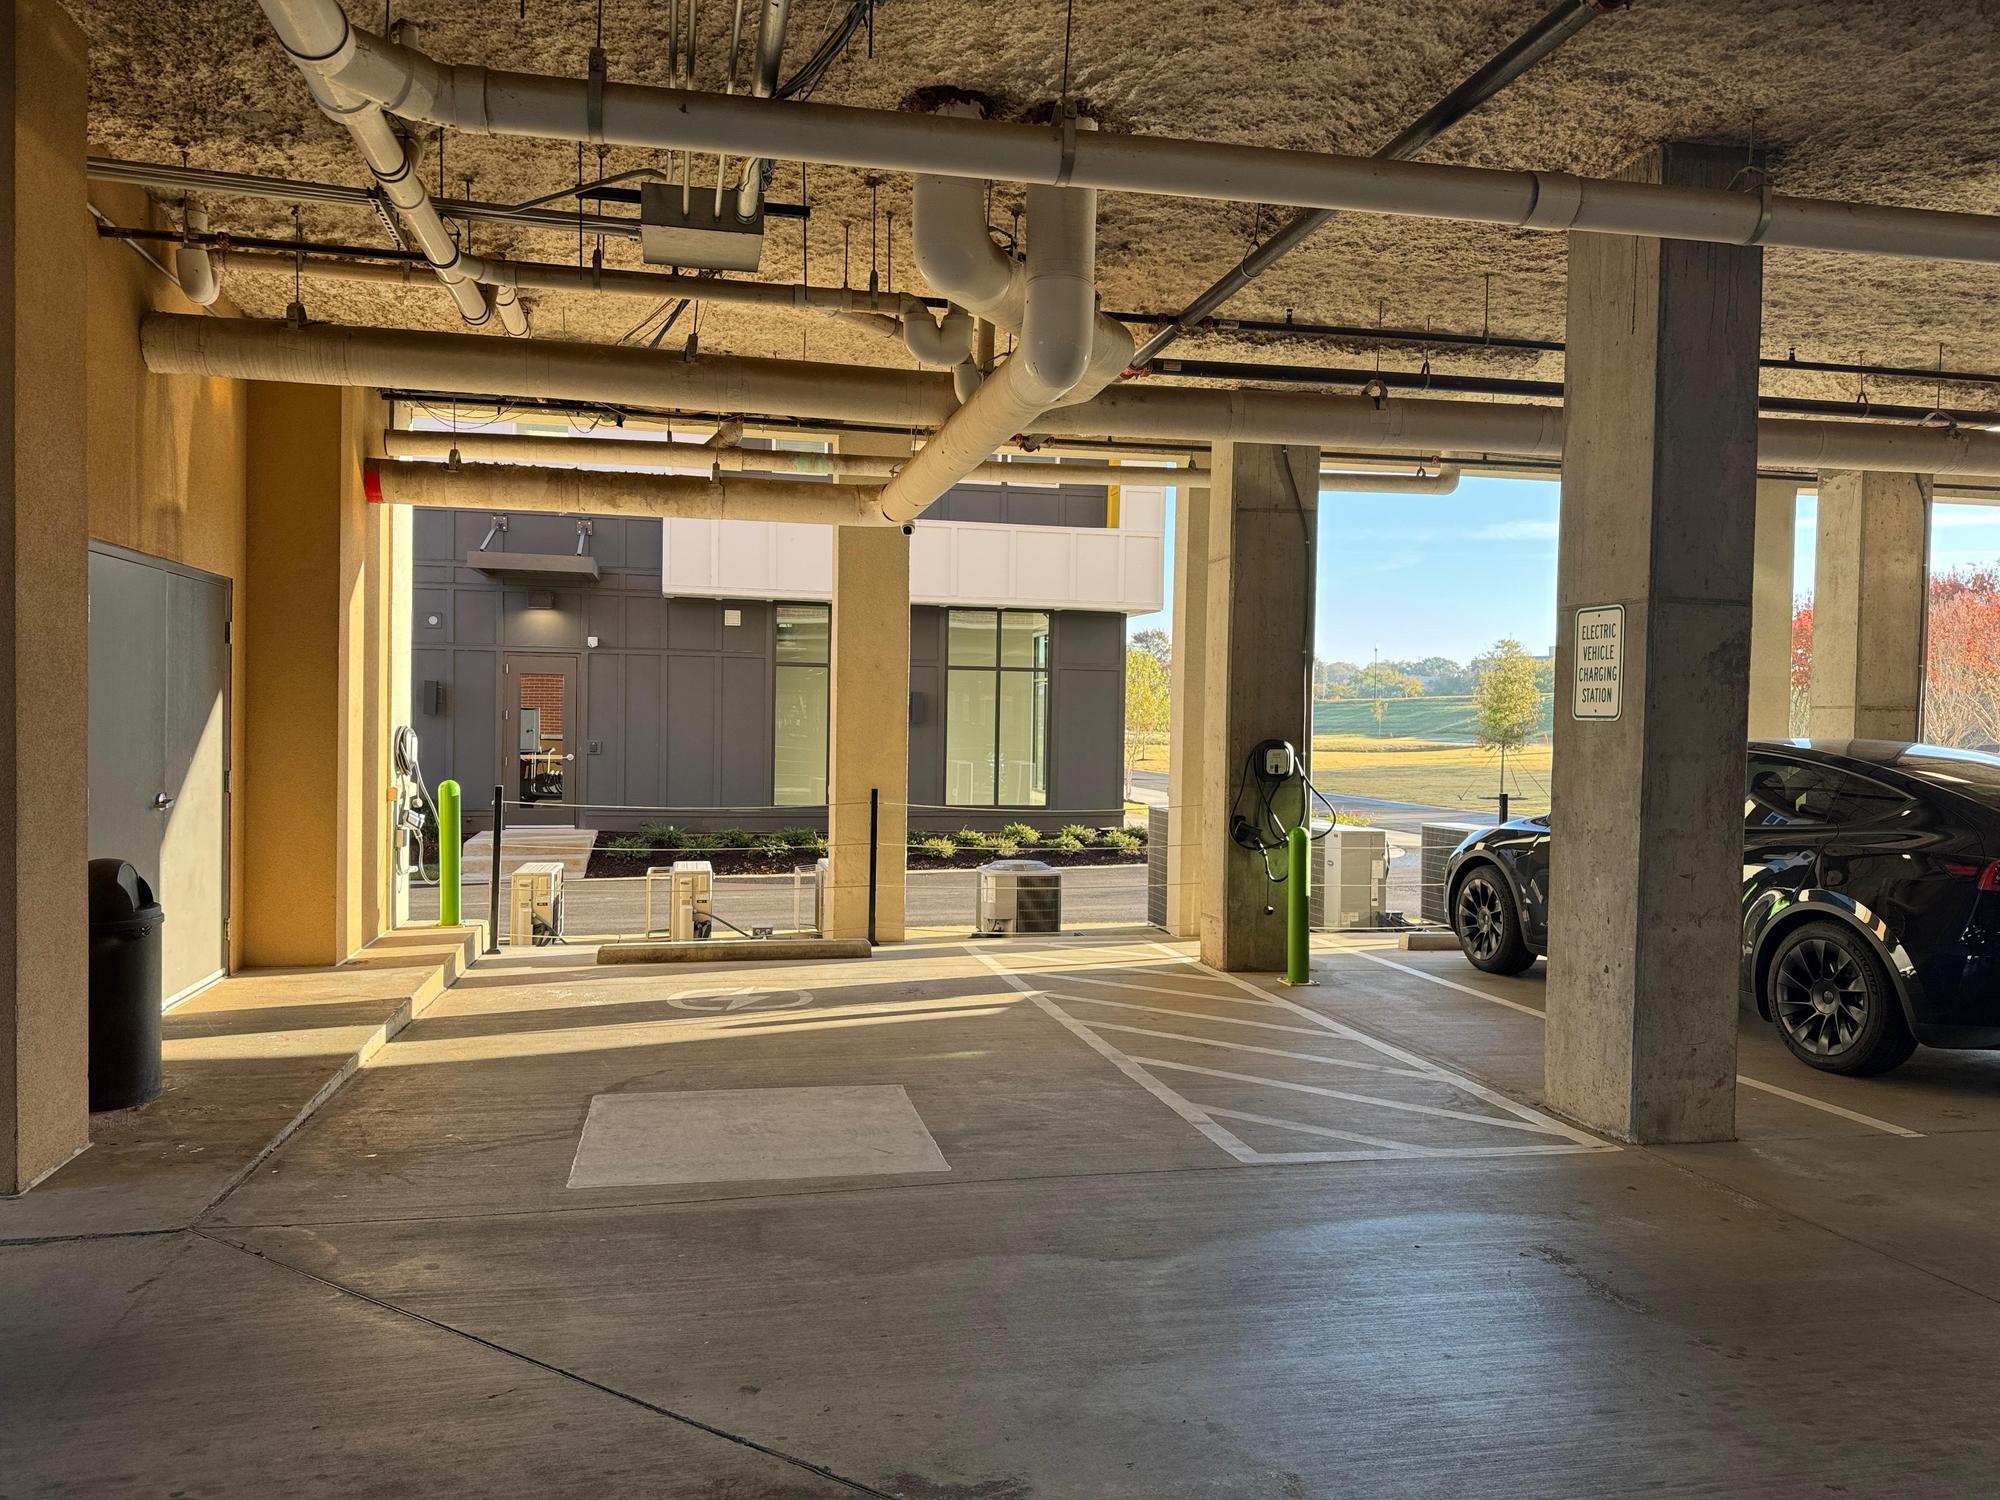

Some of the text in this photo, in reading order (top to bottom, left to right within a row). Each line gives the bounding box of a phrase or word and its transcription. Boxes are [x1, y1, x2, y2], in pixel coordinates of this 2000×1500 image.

[1582, 623, 1616, 640] ELECTRIC
[1583, 645, 1614, 660] VEHICLE
[1579, 666, 1617, 682] CHARGING
[1582, 688, 1612, 703] STATION
